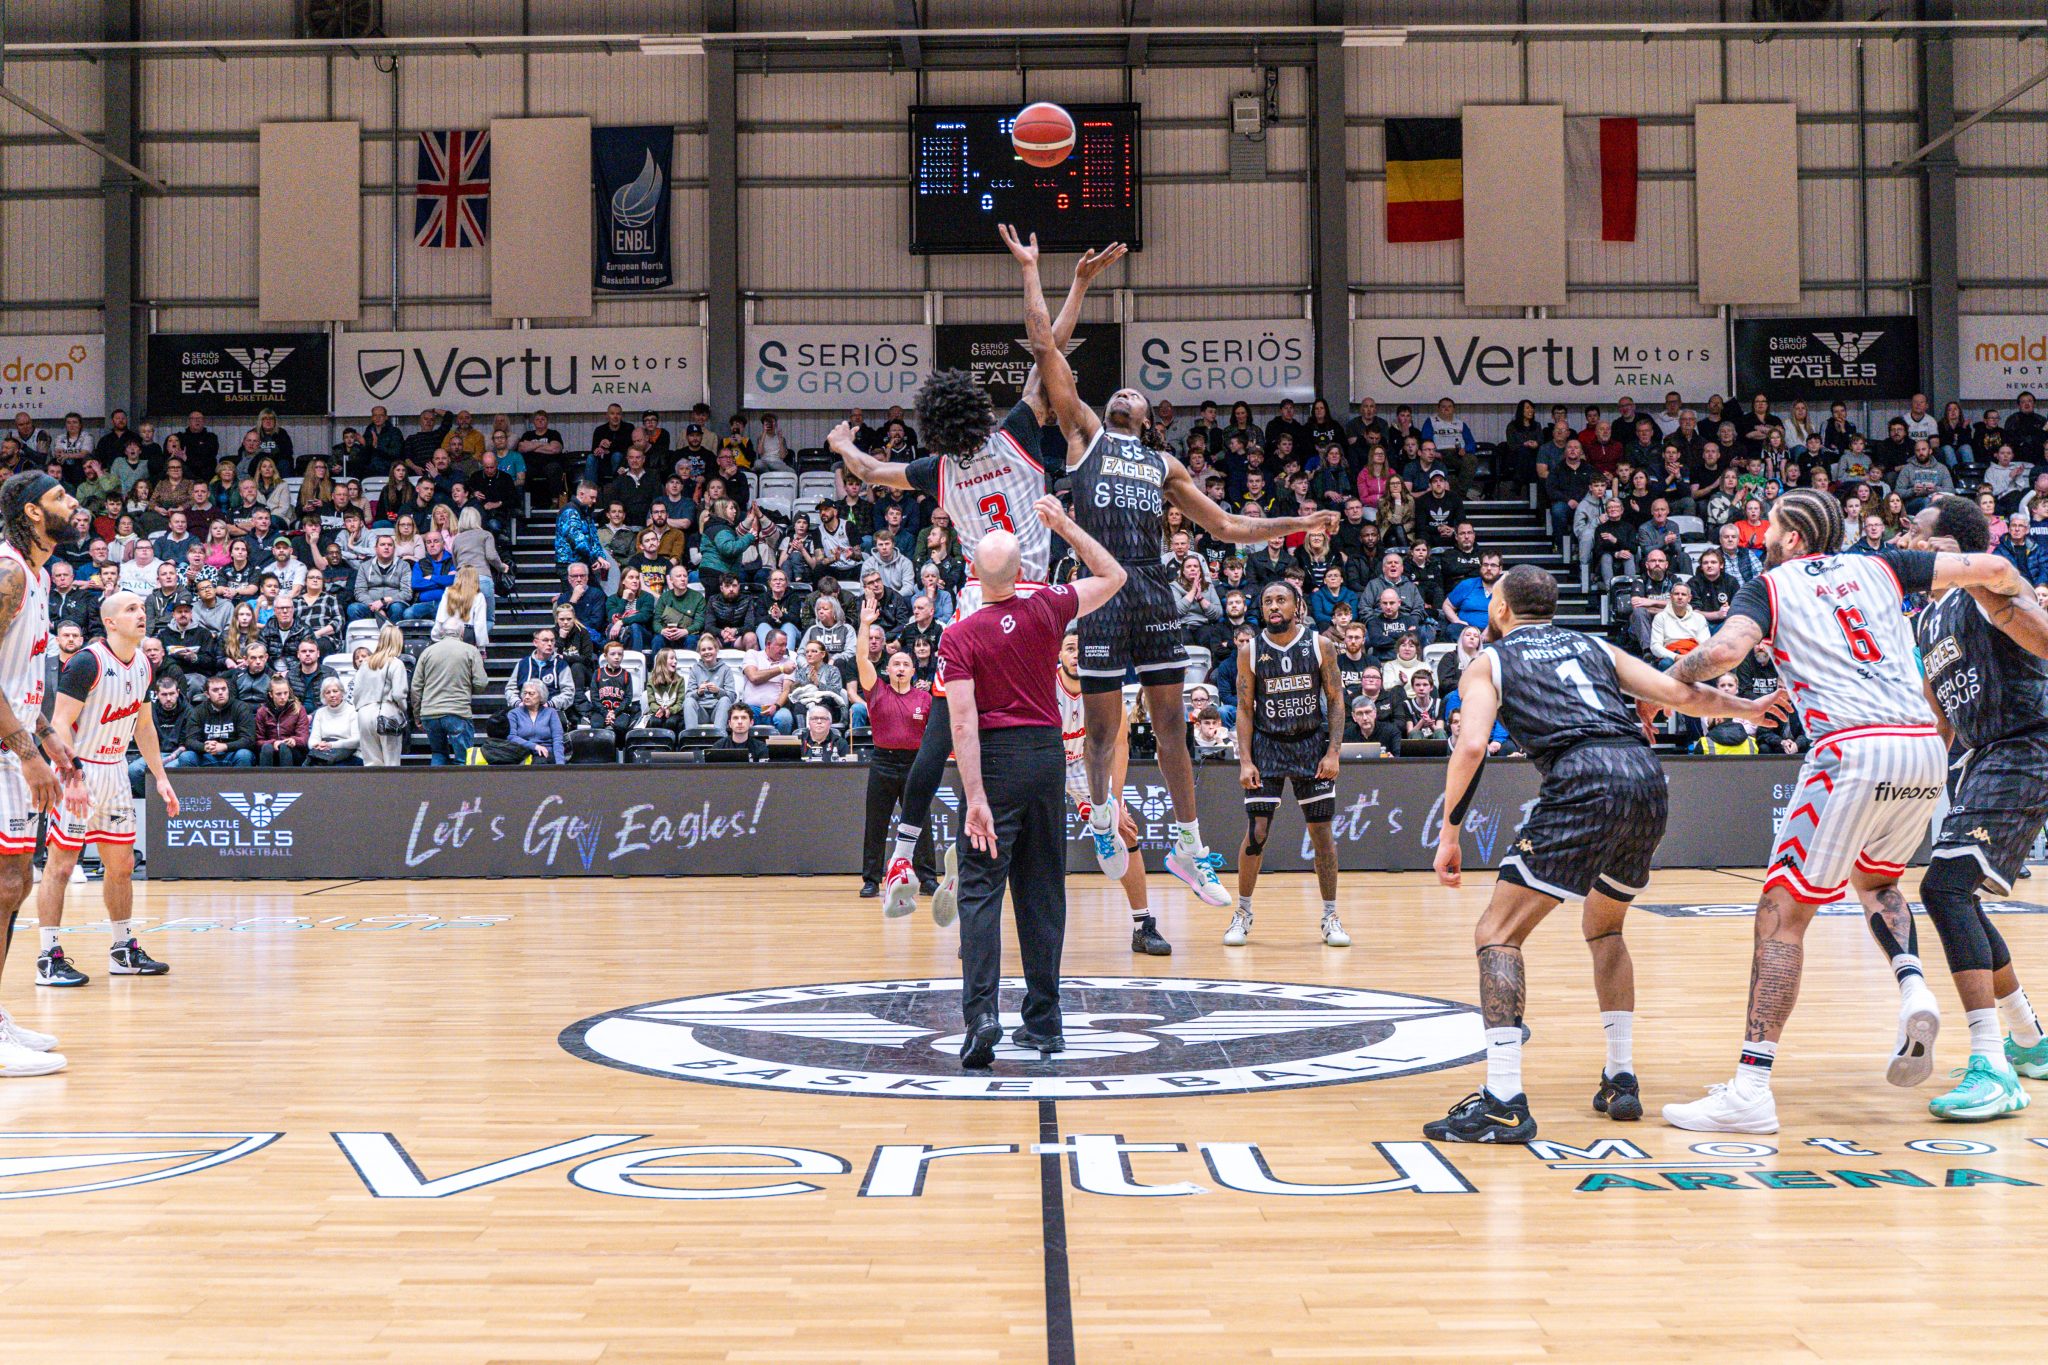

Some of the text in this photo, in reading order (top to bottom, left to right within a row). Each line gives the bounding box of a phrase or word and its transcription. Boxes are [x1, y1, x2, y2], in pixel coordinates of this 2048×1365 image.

[616, 230, 650, 250] ENBL
[606, 261, 663, 272] European North
[601, 275, 640, 285] Basketball
[798, 337, 918, 367] SERIÖS
[1181, 332, 1302, 364] SERIÖS
[971, 362, 1033, 370] NEWCASTLE
[1433, 335, 1710, 386] Vertu Motors
[1770, 356, 1831, 364] NEWCASTLE
[182, 371, 242, 379] NEWCASTLE
[413, 347, 687, 397] Vertu Motors
[1182, 366, 1302, 390] GROUP
[1614, 373, 1675, 386] ARENA
[1769, 363, 1877, 379] EAGLES
[181, 380, 287, 393] EAGLES
[592, 381, 652, 394] ARENA
[798, 371, 918, 393] GROUP
[1814, 378, 1877, 387] BASKETBALL
[225, 394, 285, 402] BASKETBALL
[1121, 444, 1144, 460] 55
[956, 466, 1012, 490] THOMAS
[1102, 456, 1161, 487] EAGLES
[977, 491, 1017, 534] 3
[1146, 620, 1181, 632] muckle
[1832, 604, 1886, 665] 6
[1929, 614, 1941, 644] 13
[1522, 641, 1592, 661] AUSTIN JR
[1281, 656, 1292, 673] 0
[1265, 675, 1312, 694] EAGLES
[1555, 658, 1604, 710] 1
[1277, 693, 1317, 709] SERIÖS
[1278, 704, 1316, 718] GROUP
[204, 723, 234, 734] EAGLES
[167, 820, 240, 829] NEWCASTLE
[404, 781, 770, 868] Let's Go Eagles!
[167, 830, 293, 847] EAGLES
[219, 848, 293, 857] BASKETBALL
[672, 1055, 1427, 1093] BASKETBALL
[329, 1131, 1480, 1201] Vertu
[1572, 1168, 2046, 1193] ARENA
